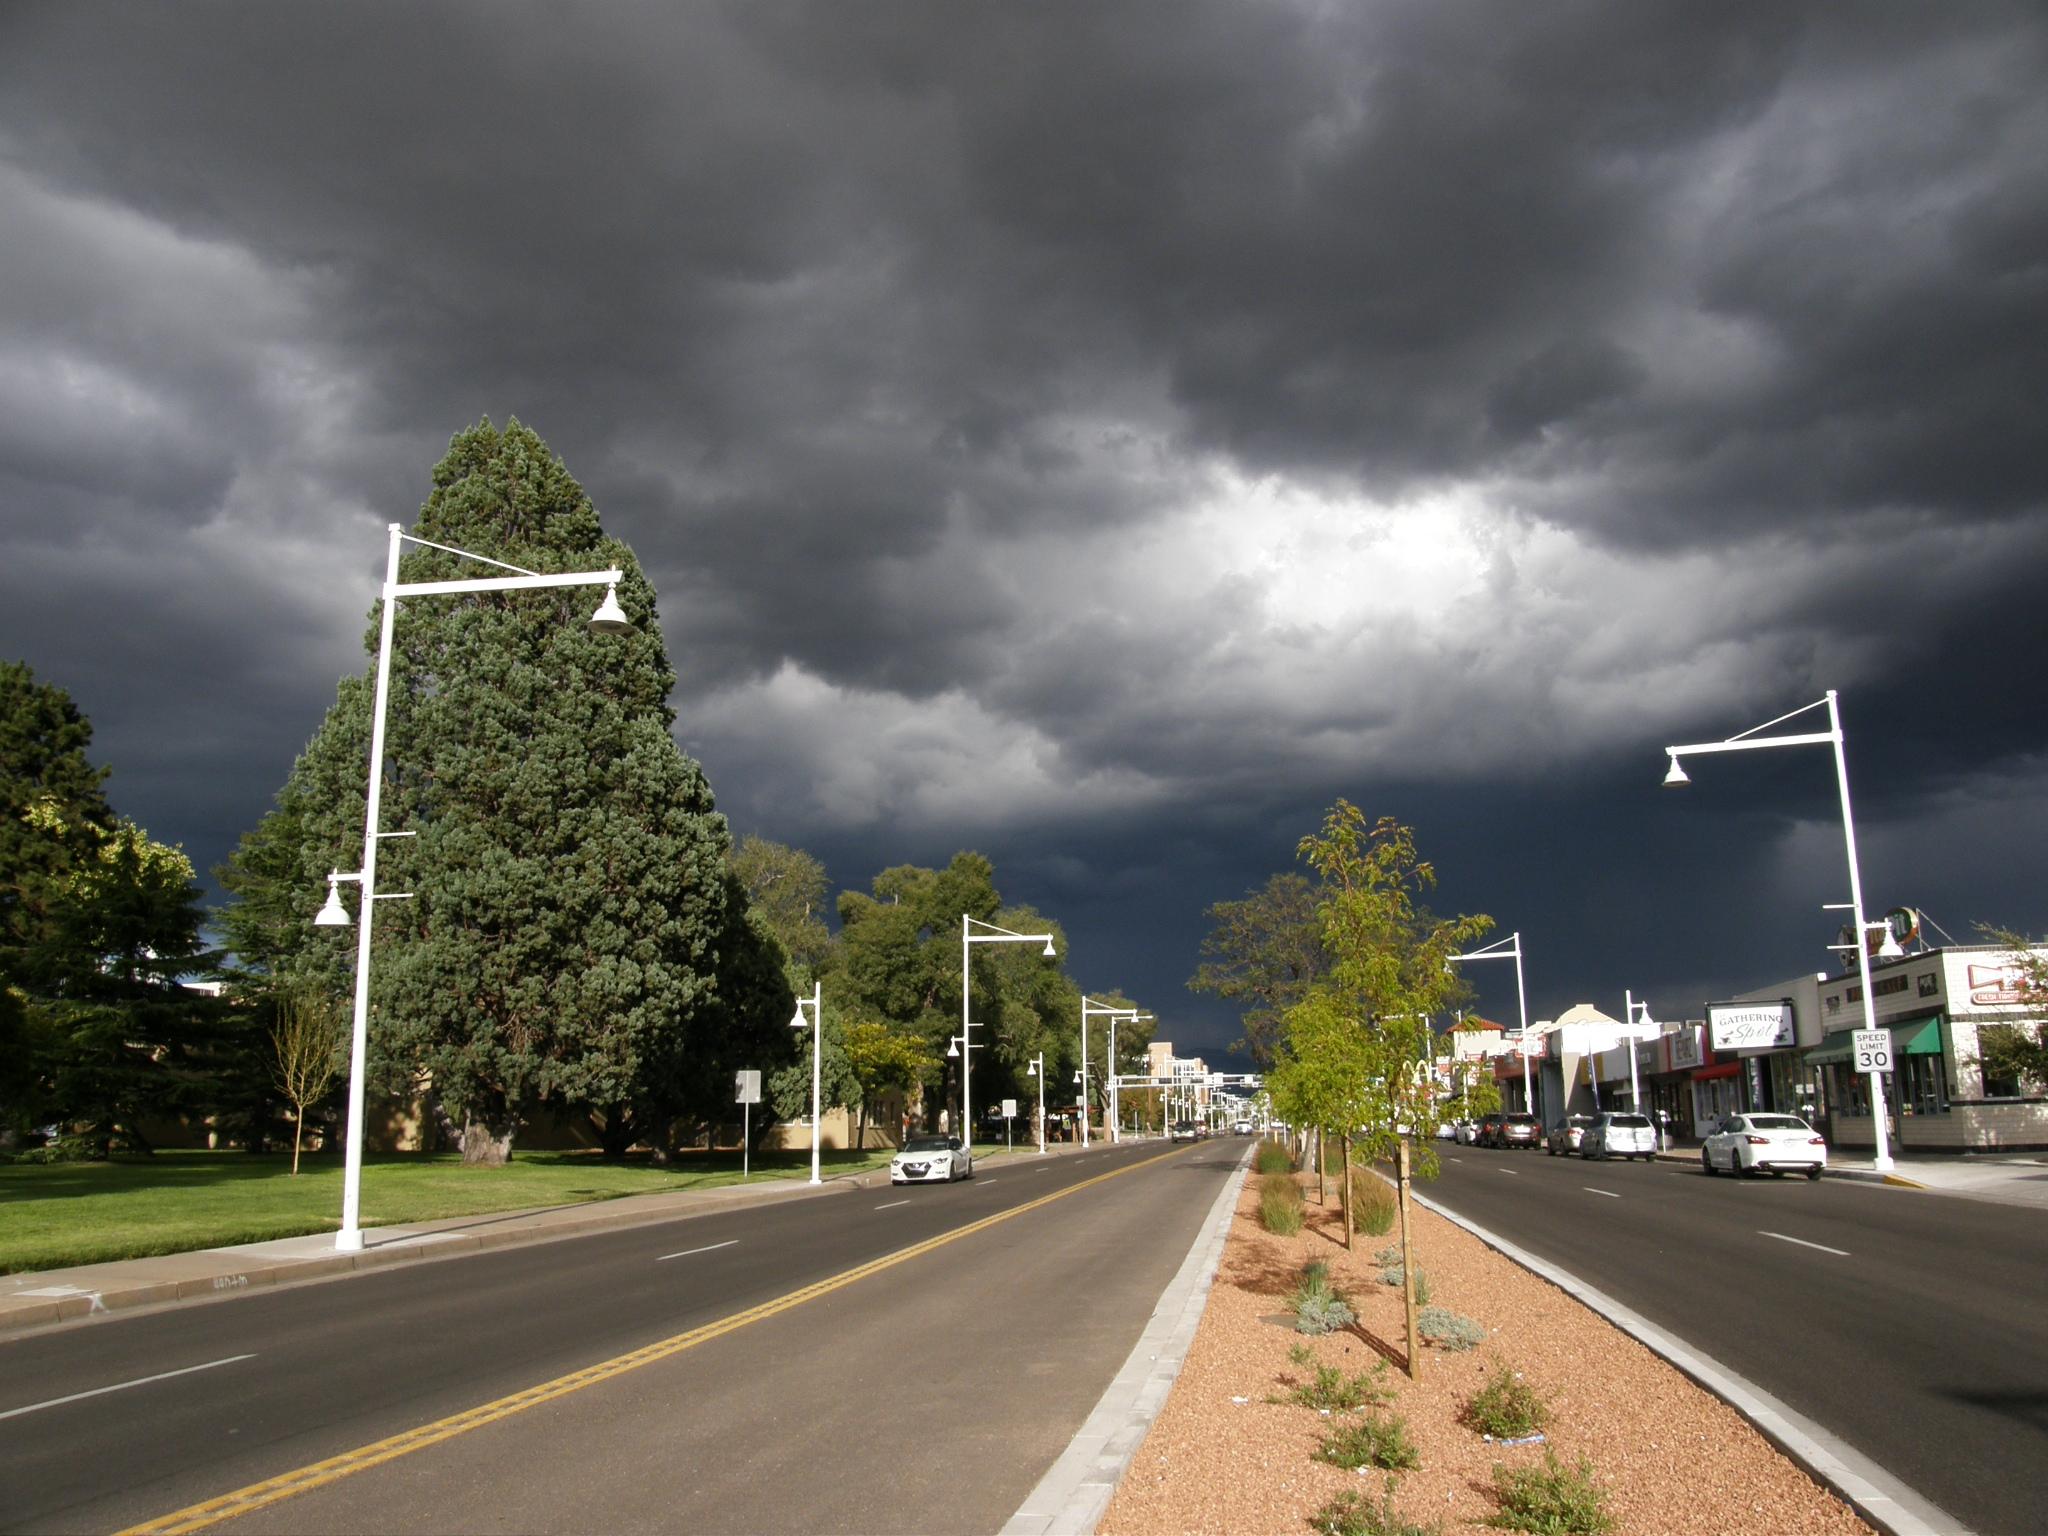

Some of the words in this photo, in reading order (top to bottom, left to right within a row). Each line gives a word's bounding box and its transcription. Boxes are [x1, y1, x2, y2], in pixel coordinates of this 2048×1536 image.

[1719, 1013, 1784, 1026] GATHERING
[1733, 1023, 1773, 1045] Spot
[1856, 1033, 1887, 1042] SPEED
[1860, 1043, 1883, 1051] LIMIT
[1860, 1052, 1887, 1067] 30
